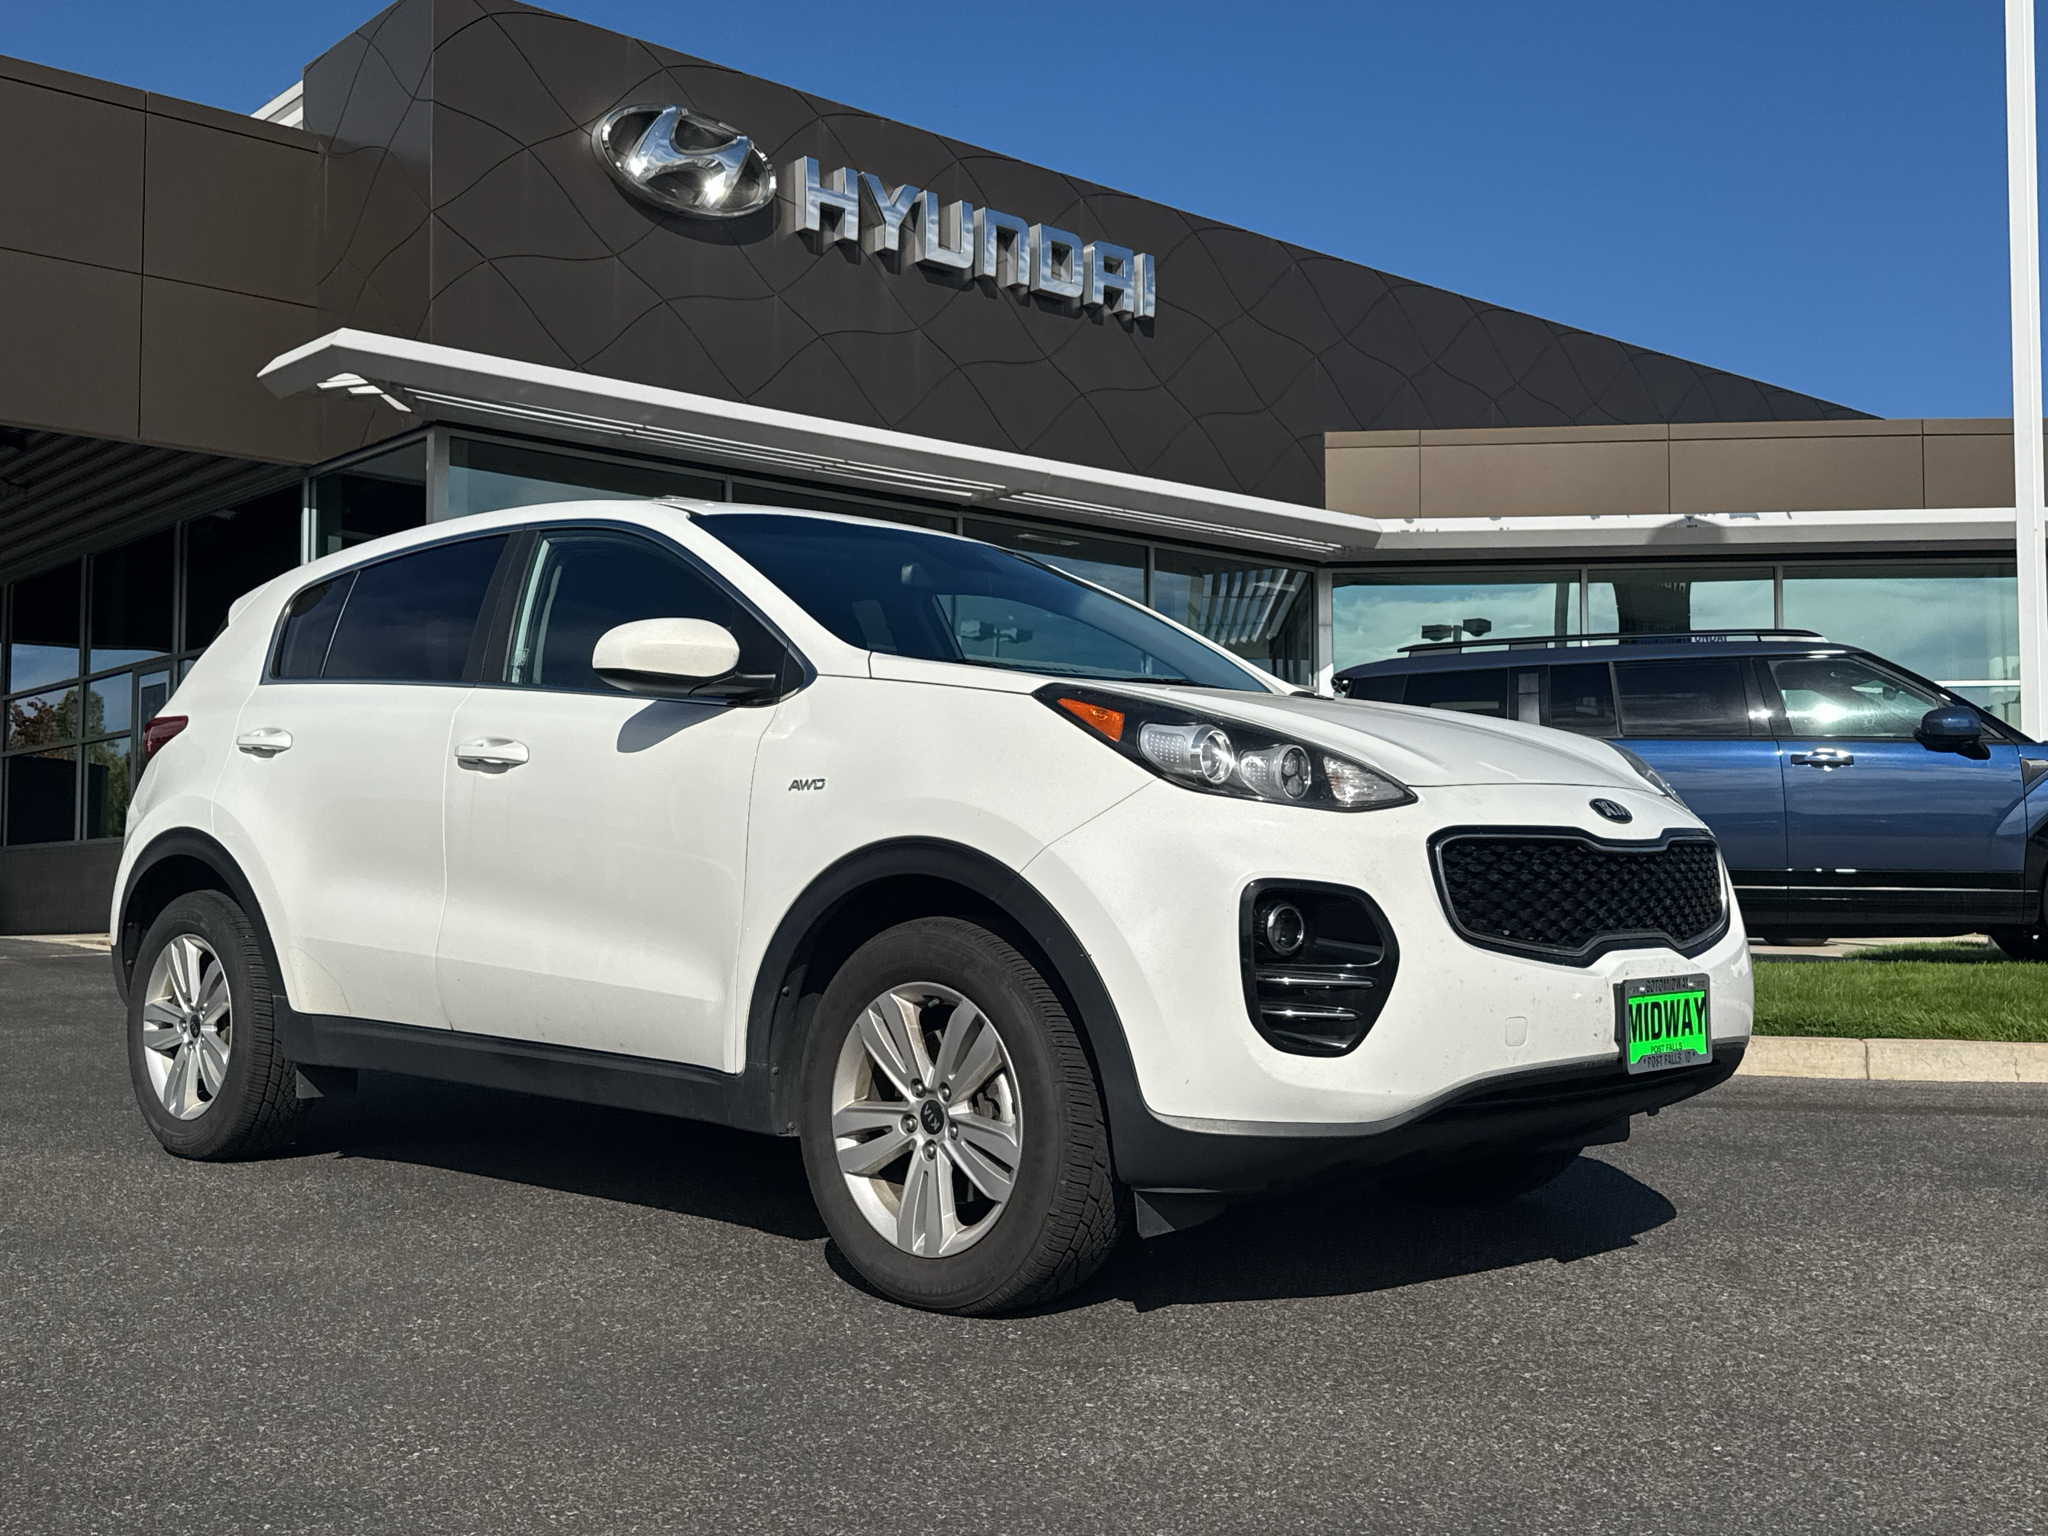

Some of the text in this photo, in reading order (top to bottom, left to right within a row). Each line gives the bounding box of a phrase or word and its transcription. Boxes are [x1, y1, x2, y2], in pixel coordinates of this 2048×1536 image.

[796, 155, 1156, 320] HYUNDAI
[788, 778, 826, 791] AWD
[1595, 801, 1631, 816] KIA
[1629, 997, 1706, 1043] MIDWAY
[1650, 1042, 1683, 1054] POST FALLS
[1647, 1055, 1663, 1068] POST
[923, 1104, 940, 1131] KIA
